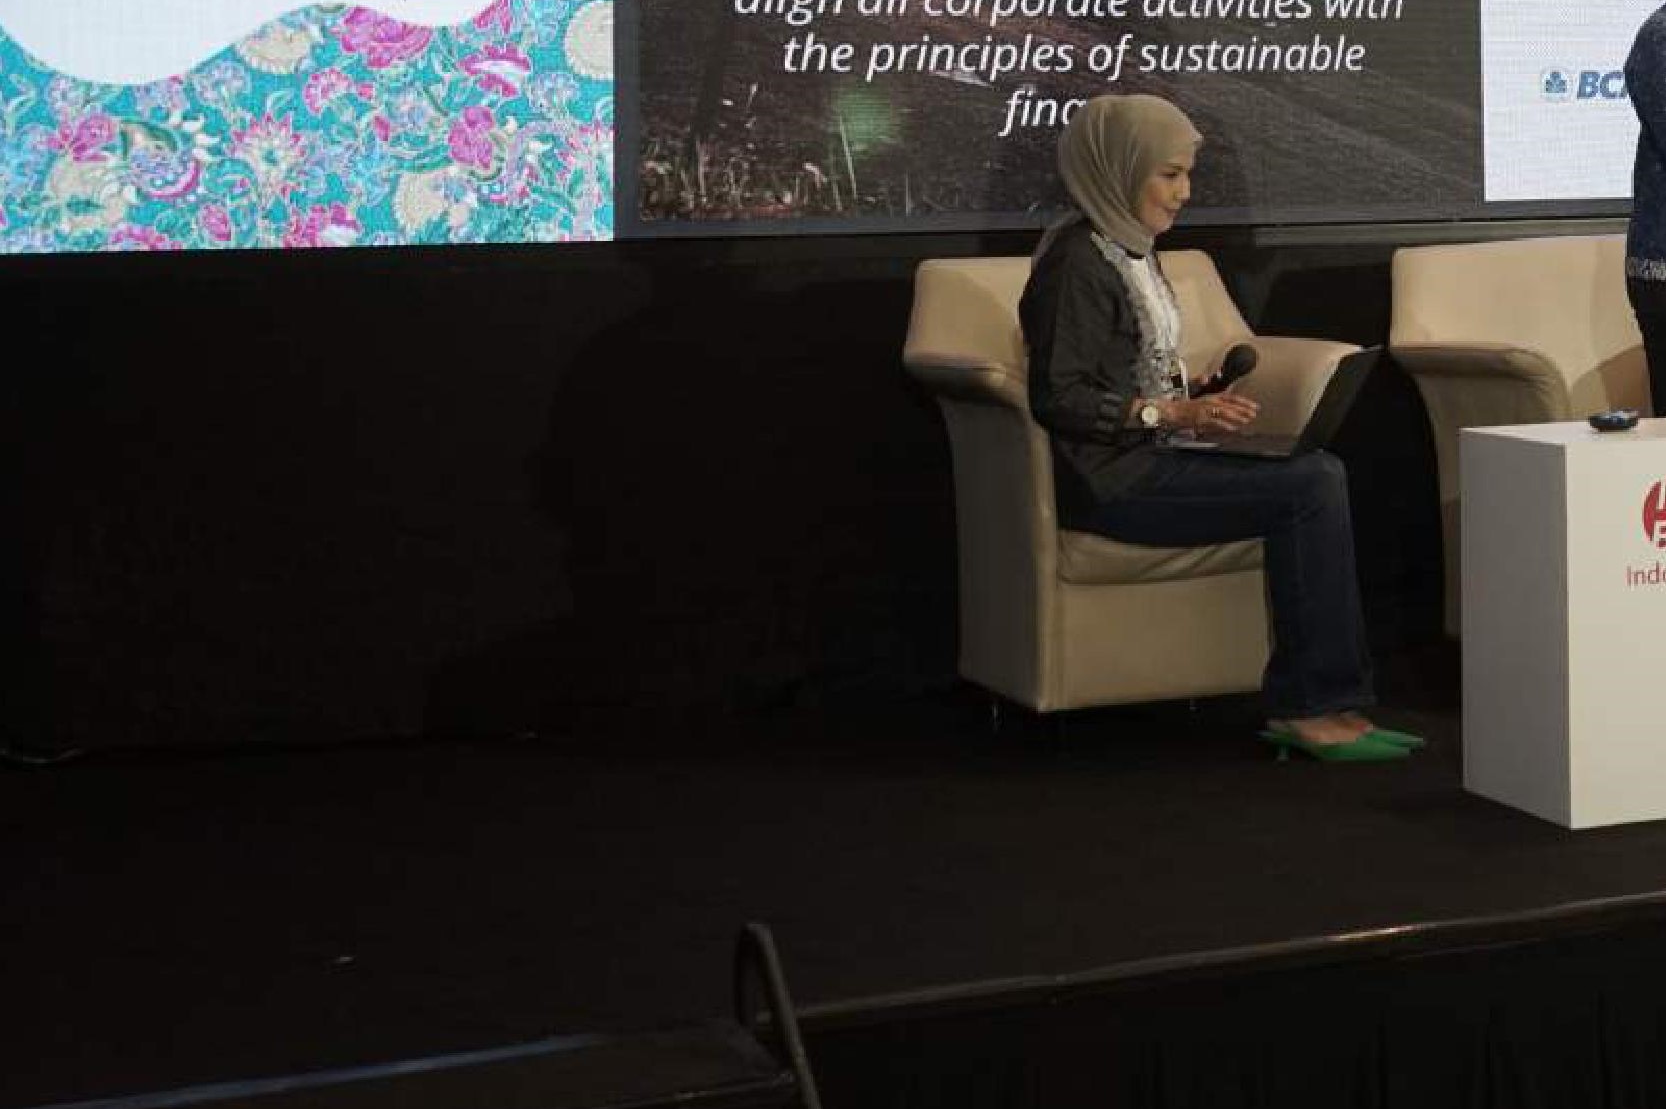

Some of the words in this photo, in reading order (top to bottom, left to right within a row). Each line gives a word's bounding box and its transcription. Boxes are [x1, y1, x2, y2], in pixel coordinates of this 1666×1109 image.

[782, 32, 855, 72] the
[865, 33, 1074, 82] principles
[1087, 33, 1134, 81] of
[1139, 34, 1366, 73] sustainable
[1576, 70, 1626, 100] BC
